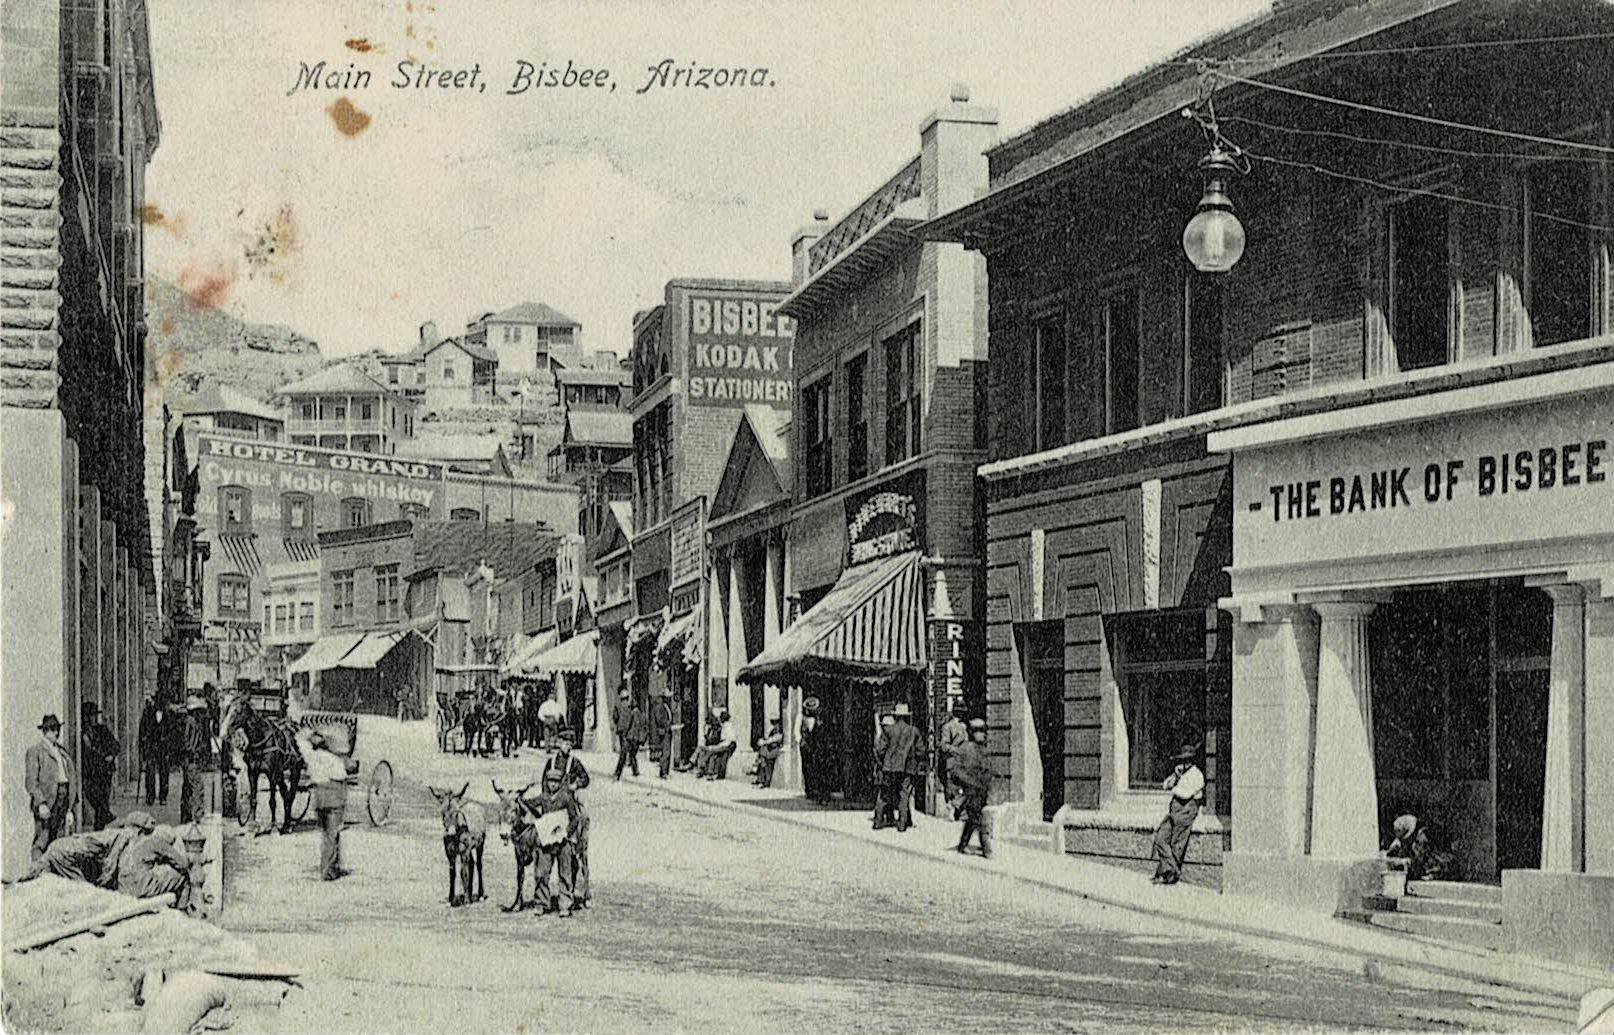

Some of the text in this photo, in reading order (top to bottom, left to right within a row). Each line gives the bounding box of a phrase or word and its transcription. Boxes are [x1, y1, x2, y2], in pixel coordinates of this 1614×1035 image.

[695, 343, 779, 372] KODAK
[209, 439, 433, 479] HOTEL GRAND.
[279, 470, 344, 497] Noble
[1269, 479, 1321, 522] THE
[1329, 467, 1411, 516] BANK
[1424, 460, 1464, 502] OF
[1478, 440, 1606, 497] BISBEE
